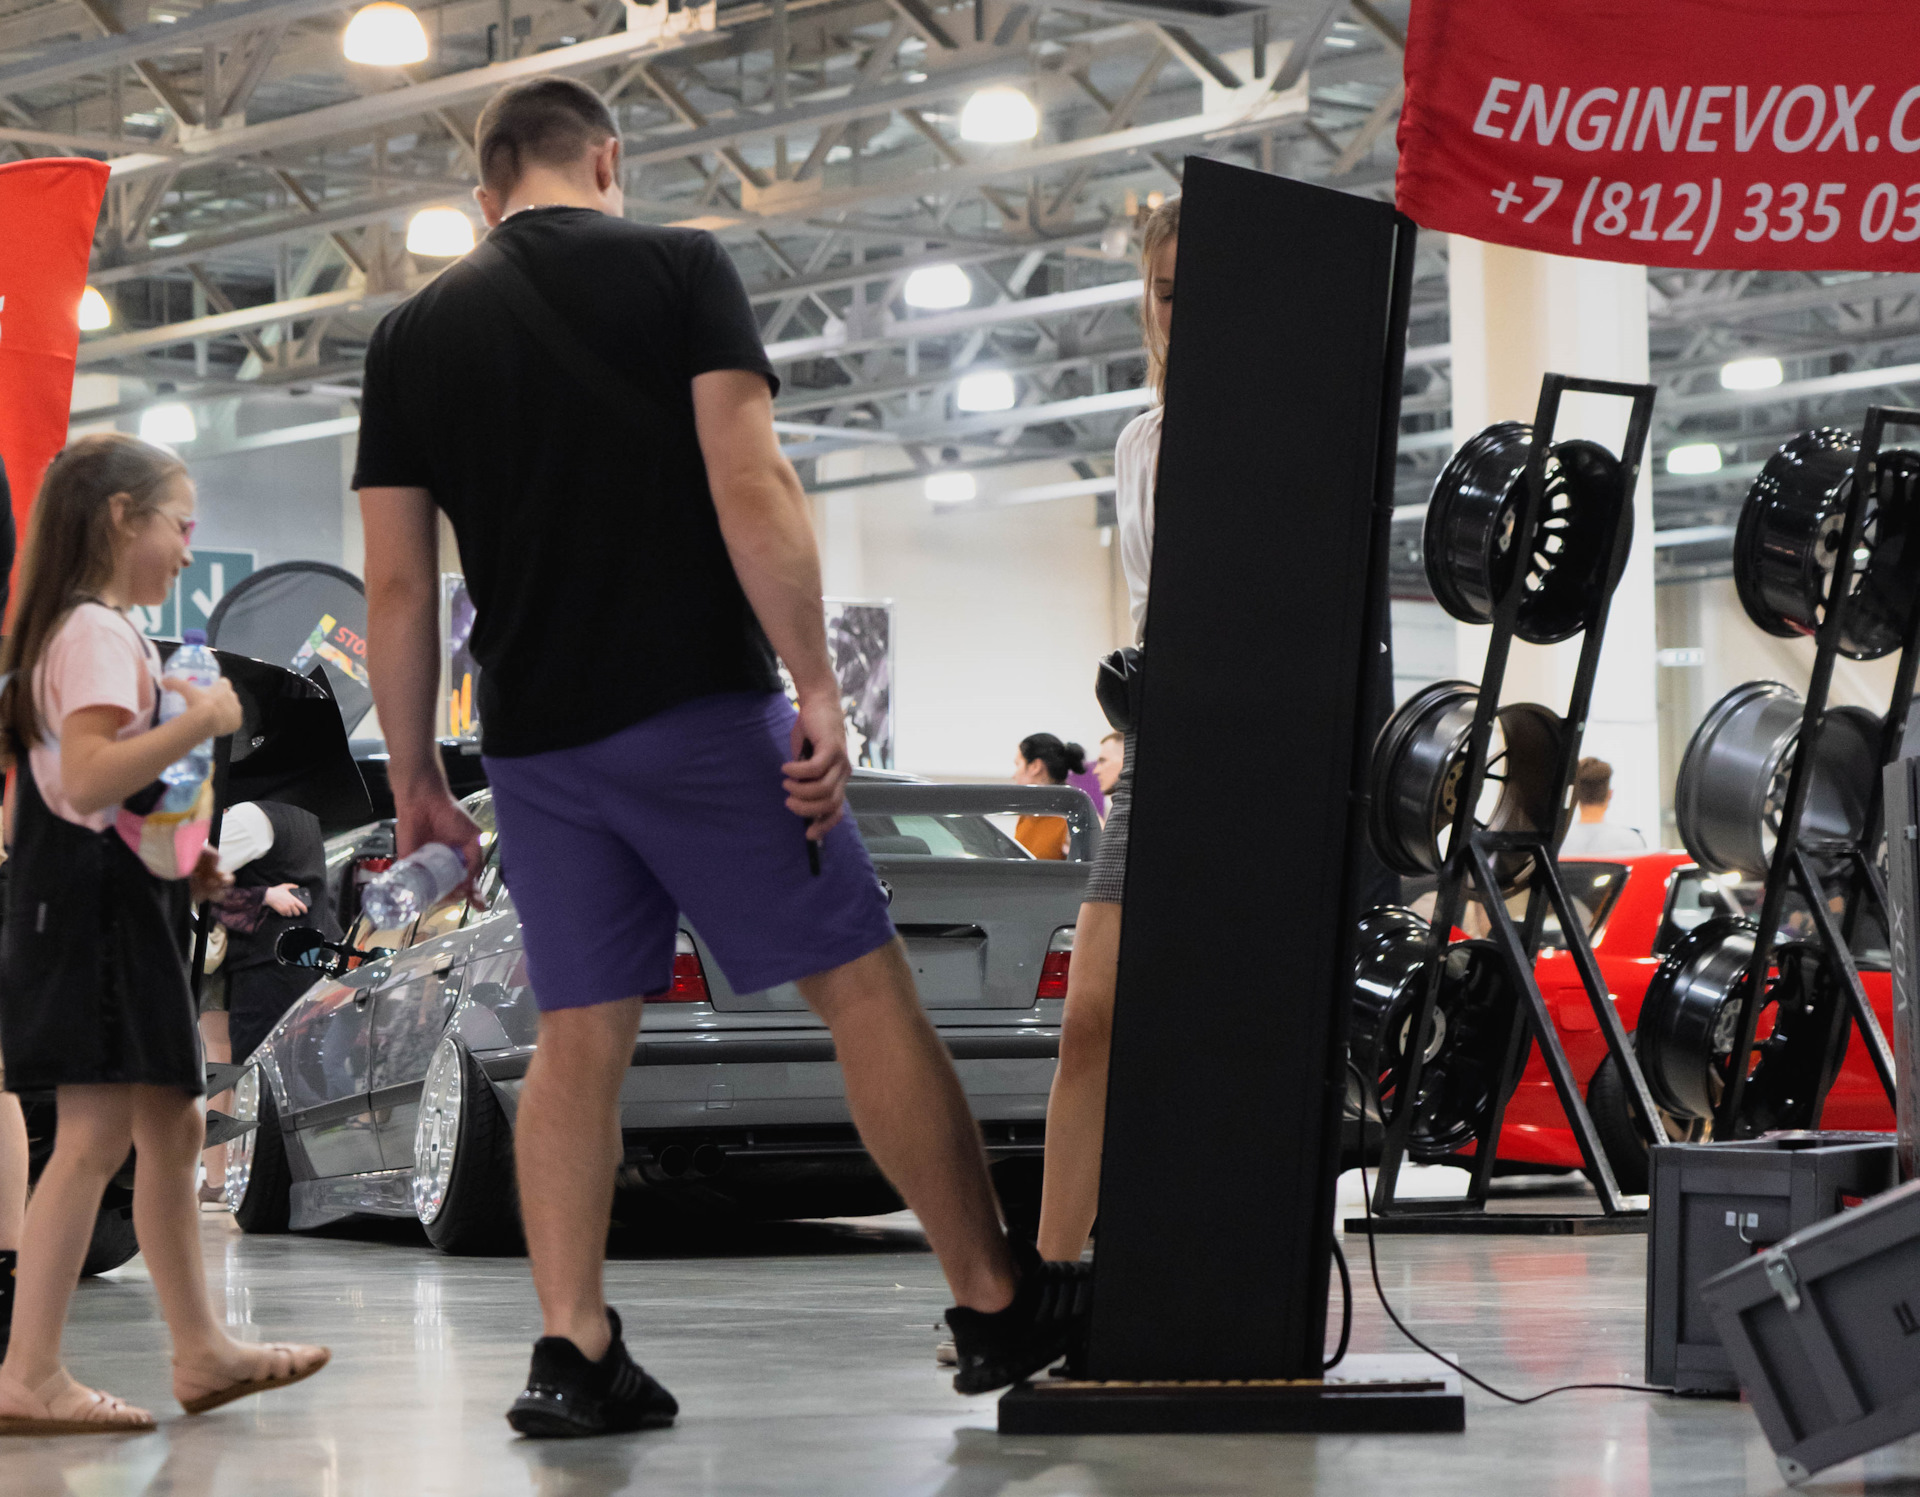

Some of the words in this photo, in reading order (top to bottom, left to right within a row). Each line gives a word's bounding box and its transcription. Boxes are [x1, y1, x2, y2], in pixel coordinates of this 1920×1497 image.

[1473, 77, 1920, 153] ENGINEVOX.C
[1490, 175, 1563, 224] +7
[1572, 176, 1722, 255] (812)
[1734, 183, 1847, 243] 335
[334, 626, 367, 659] STO
